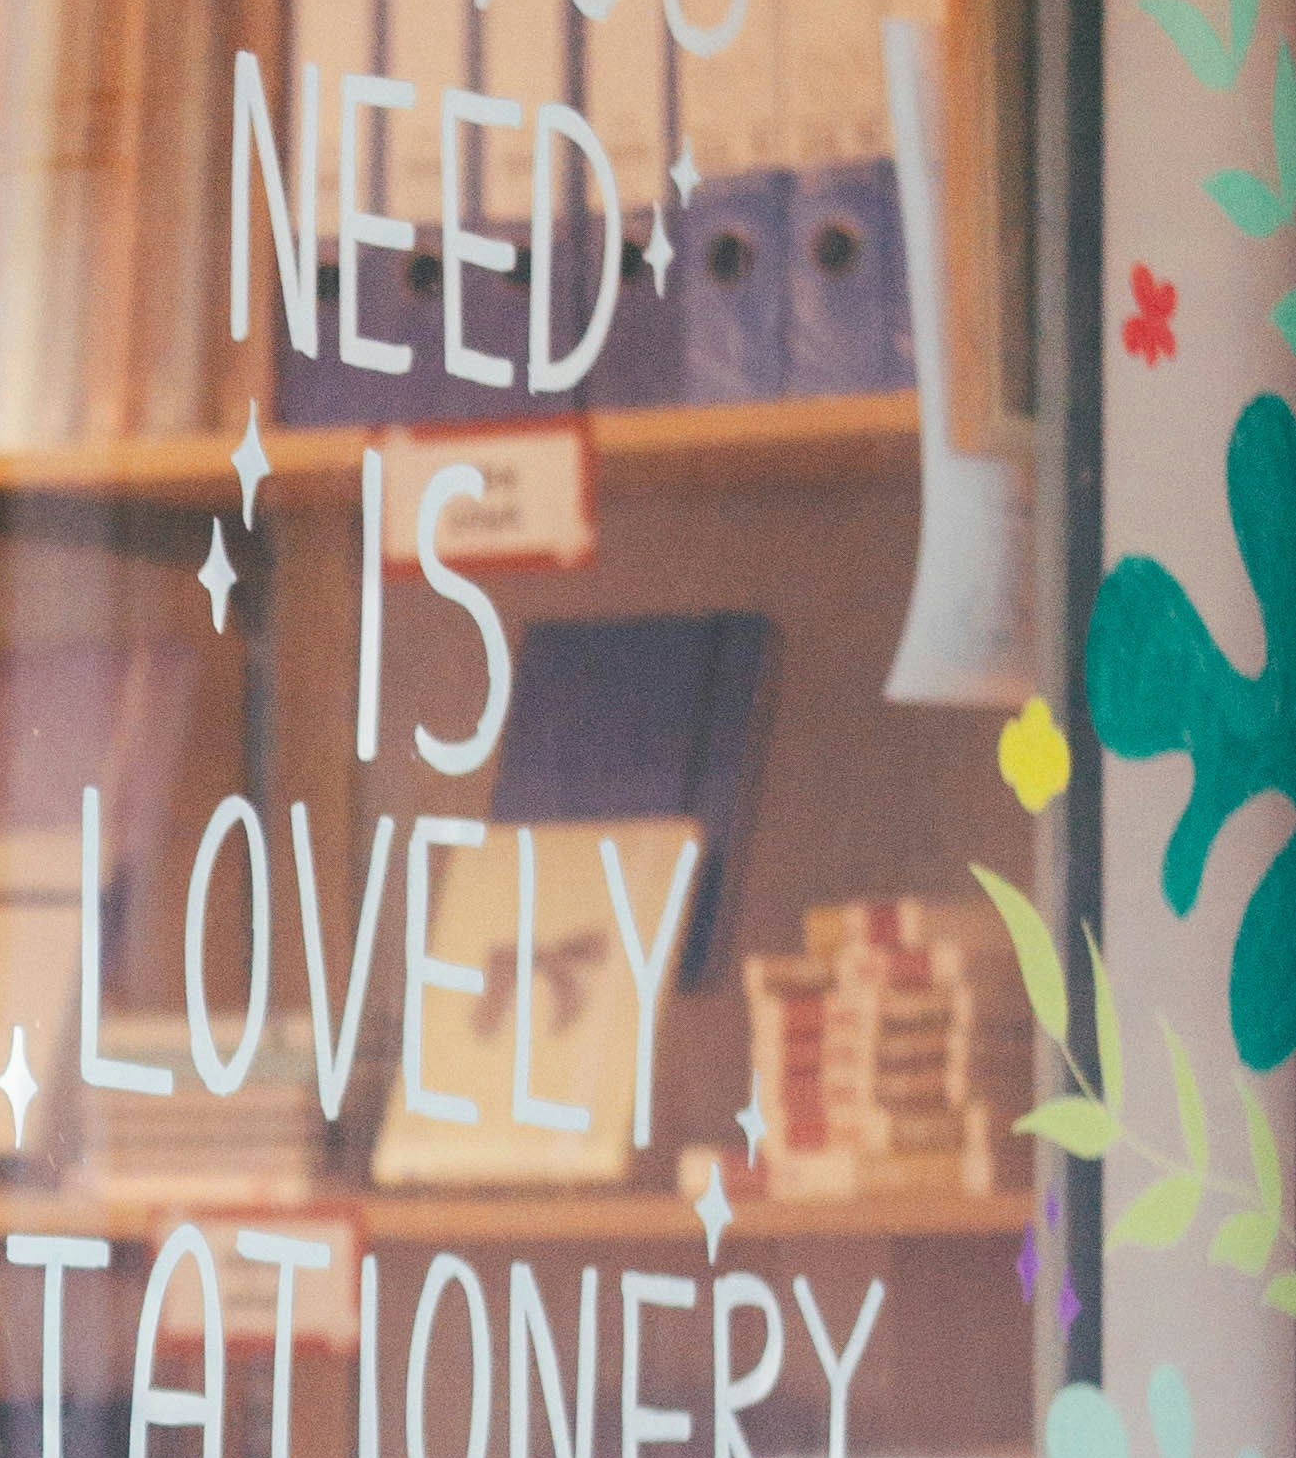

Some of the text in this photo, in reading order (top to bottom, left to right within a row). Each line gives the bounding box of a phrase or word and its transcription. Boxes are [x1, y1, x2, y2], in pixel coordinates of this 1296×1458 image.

[229, 49, 624, 396] NEED
[354, 448, 514, 775] IS
[80, 786, 699, 1149] LOVELY
